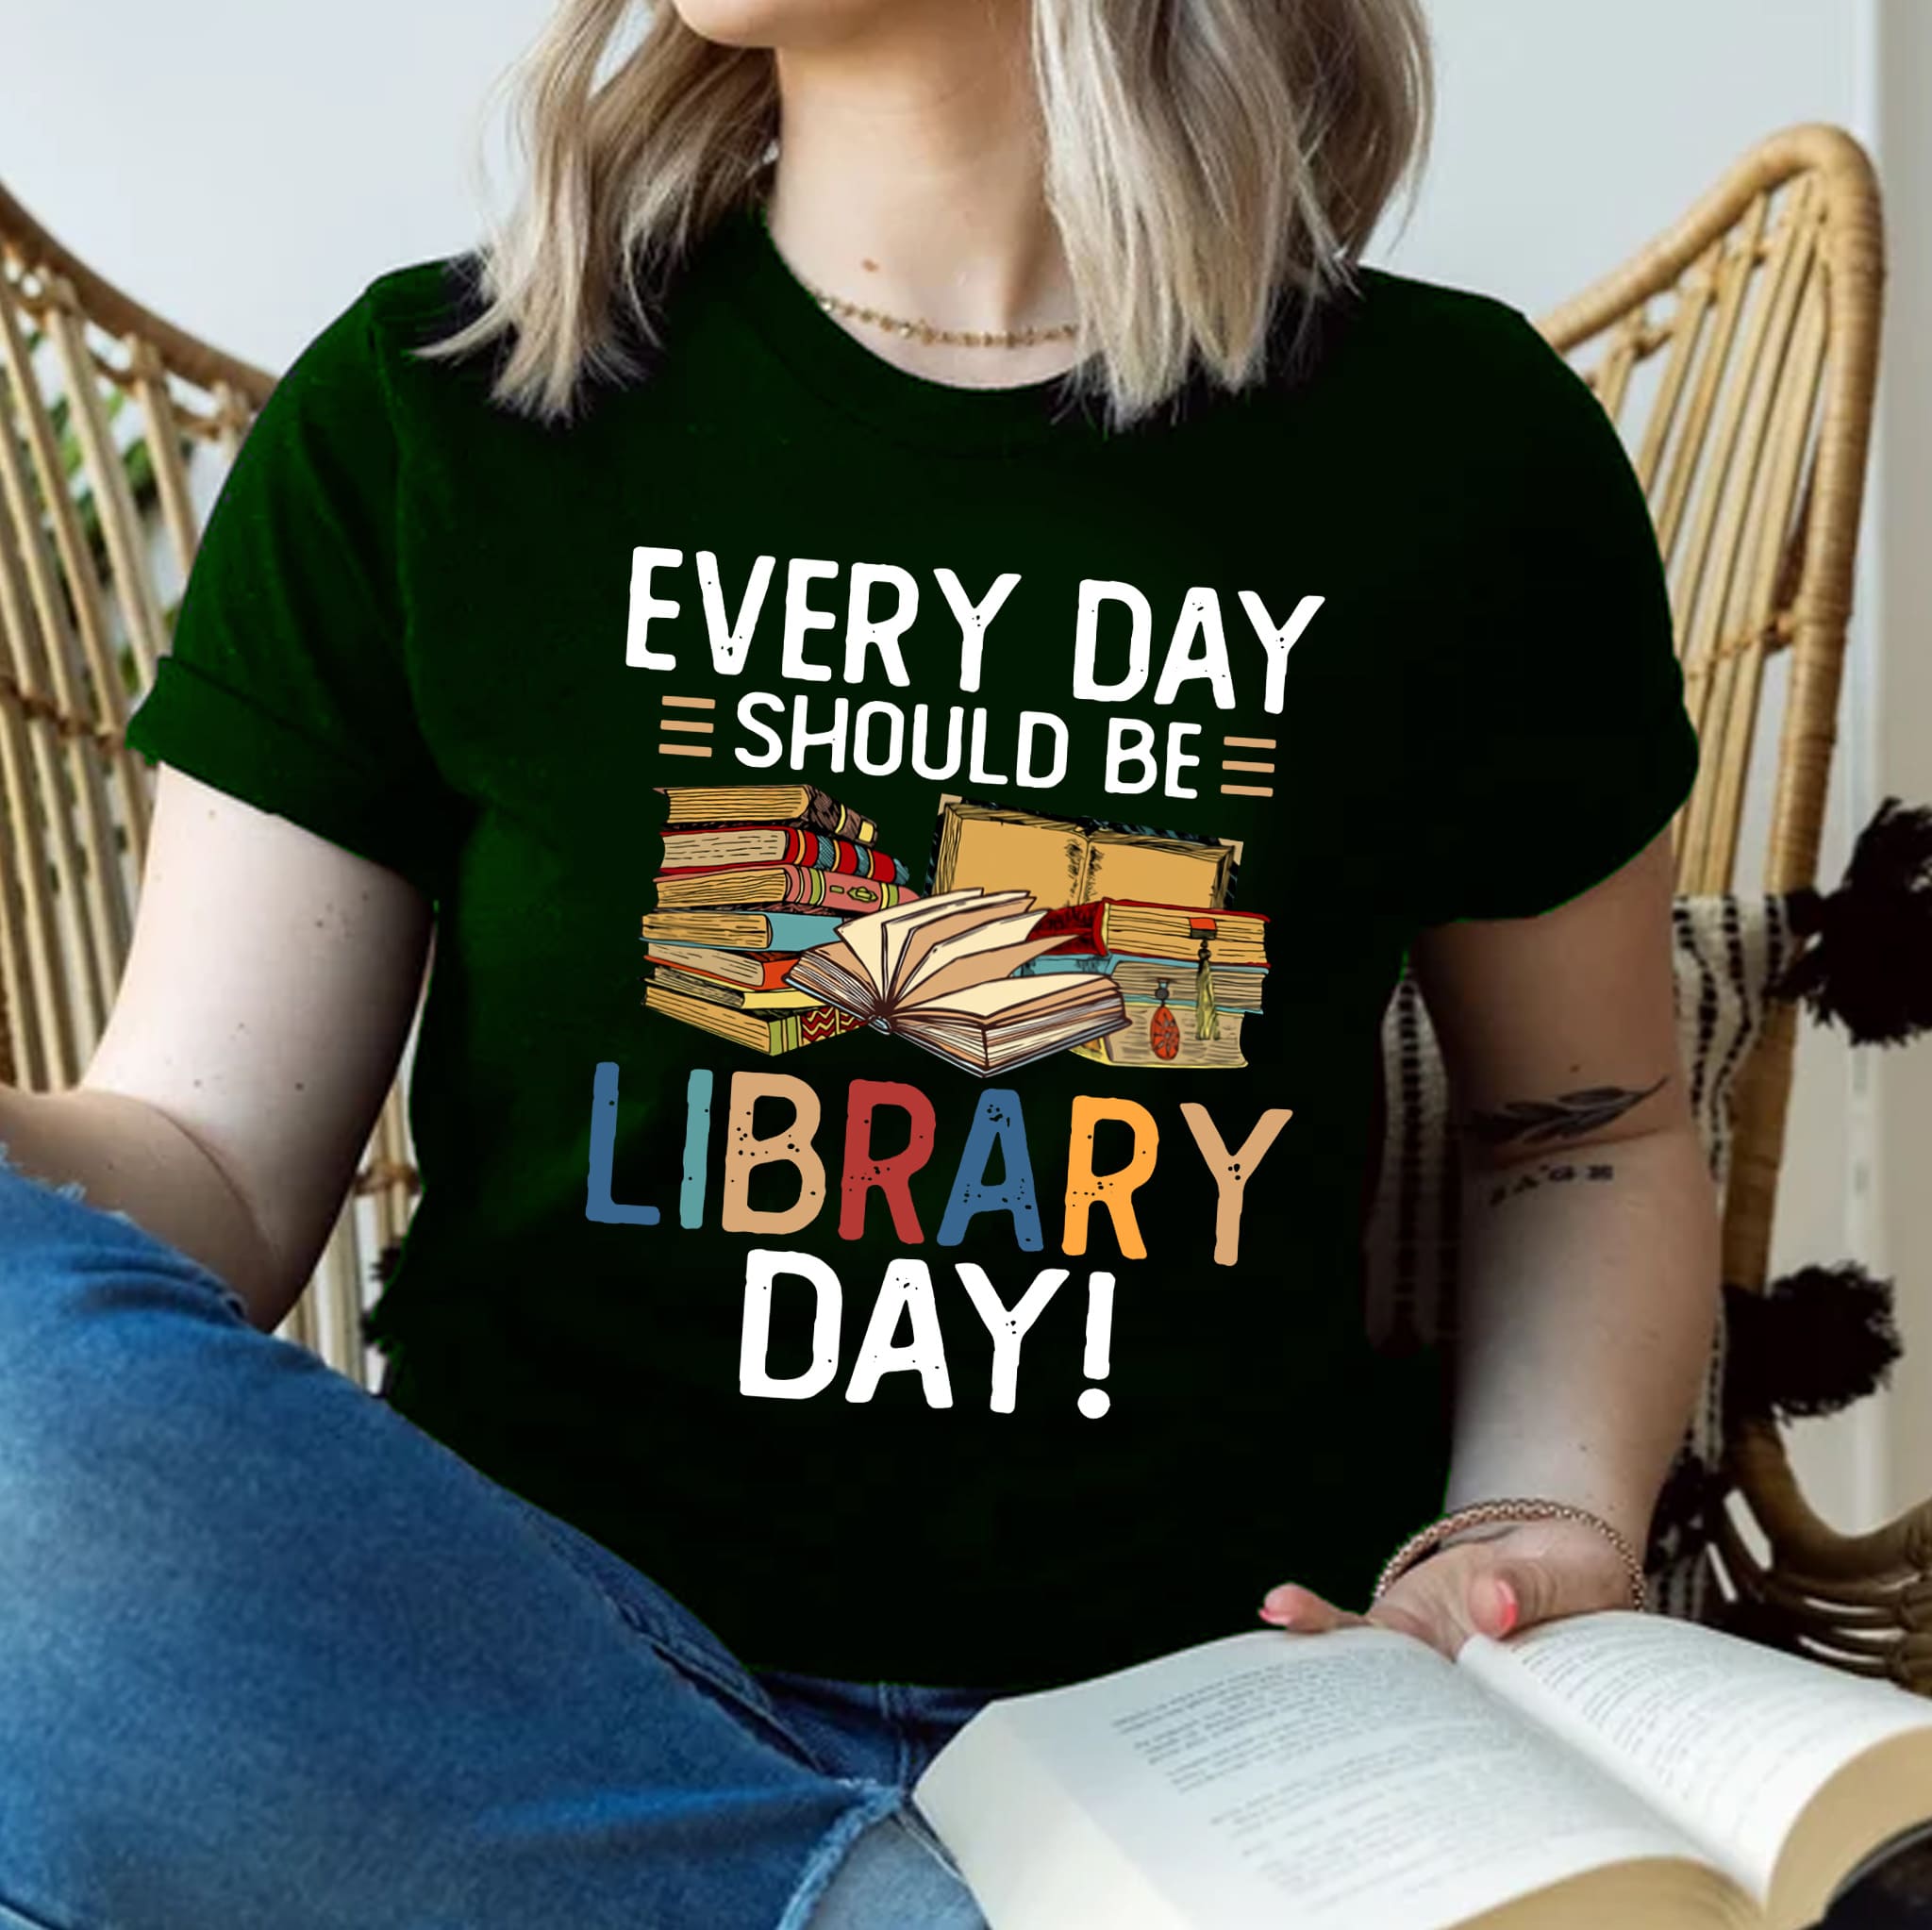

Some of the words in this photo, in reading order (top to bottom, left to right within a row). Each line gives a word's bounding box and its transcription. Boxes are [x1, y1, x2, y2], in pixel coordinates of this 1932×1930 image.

[625, 546, 1021, 692] EVERY
[1073, 579, 1325, 714] DAY
[735, 691, 1069, 789] SHOULD
[1105, 719, 1202, 799] BE
[585, 1061, 1292, 1266] LIBRARY
[739, 1249, 1115, 1419] DAY!
